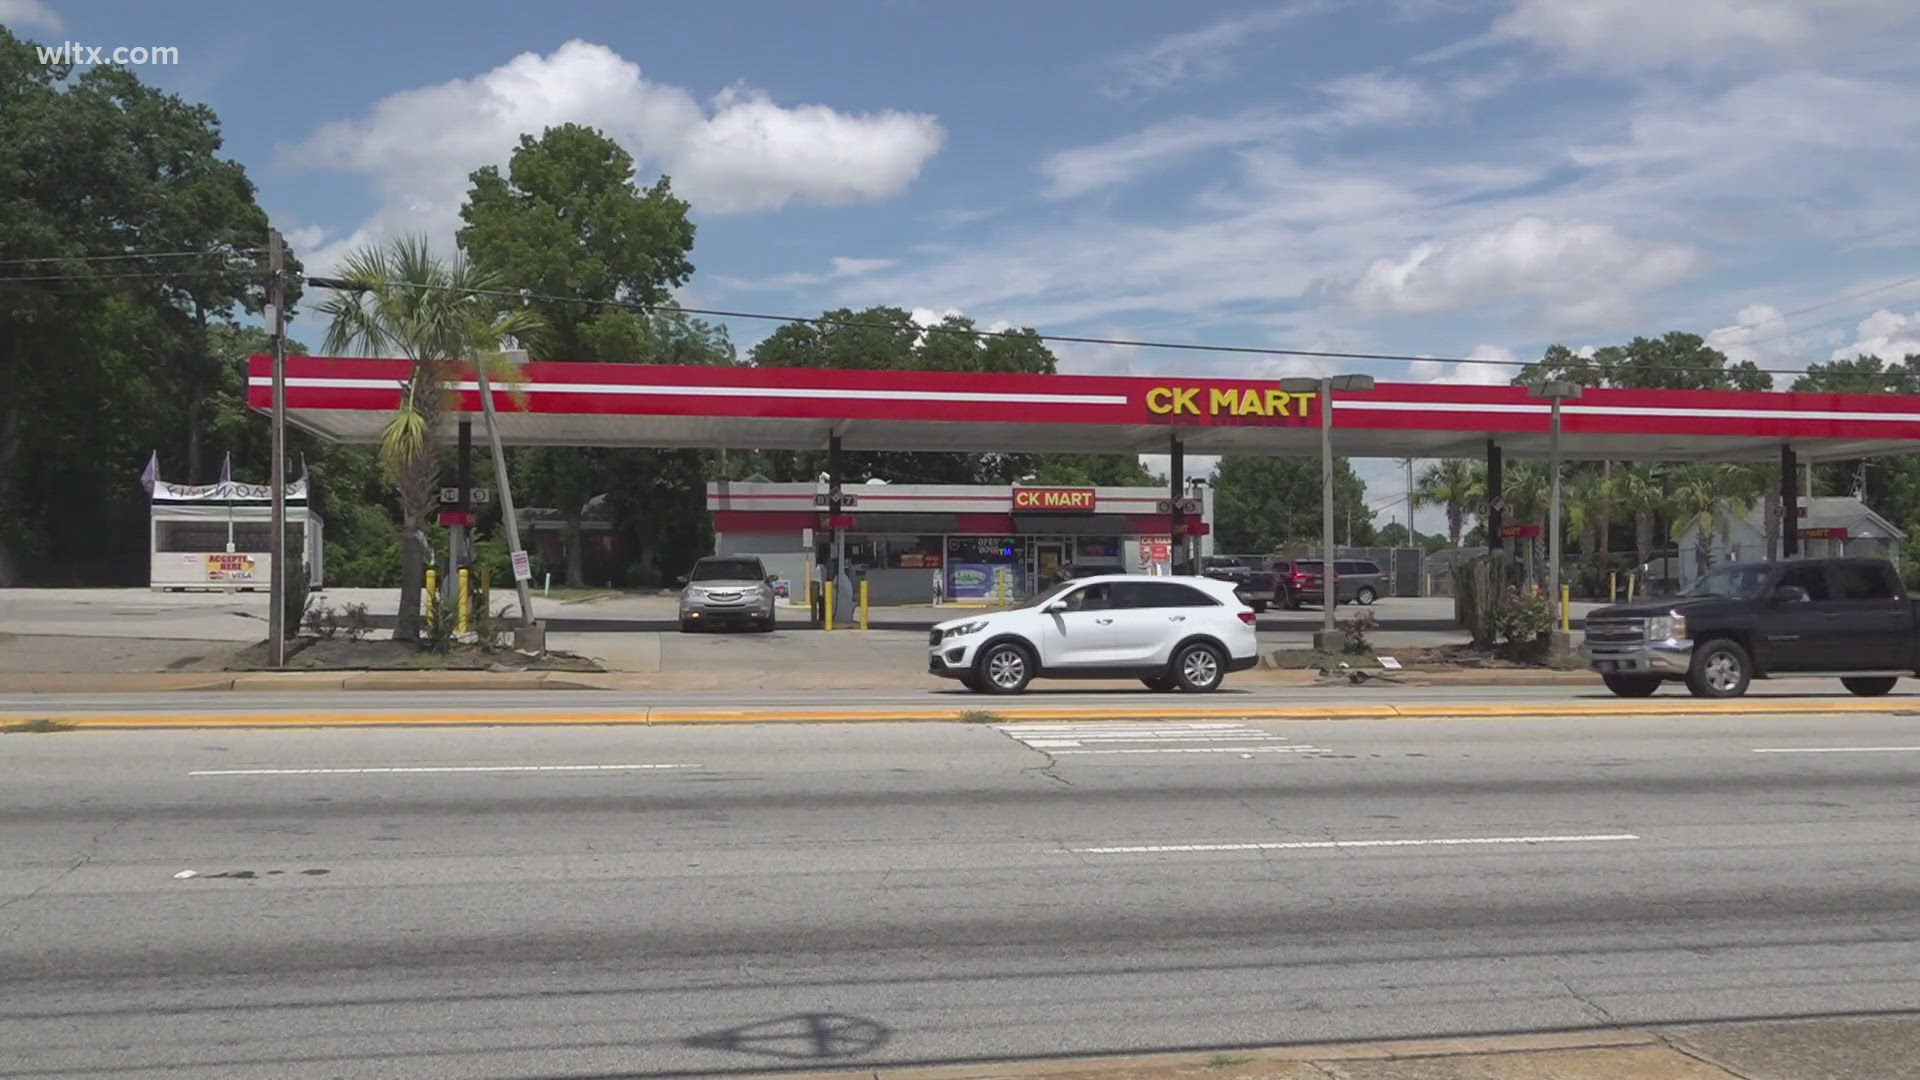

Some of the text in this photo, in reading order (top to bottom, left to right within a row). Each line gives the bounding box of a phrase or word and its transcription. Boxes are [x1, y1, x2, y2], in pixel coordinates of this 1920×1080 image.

[1146, 387, 1316, 417] CK MART
[166, 482, 298, 498] FIREWORS
[1015, 492, 1093, 507] CK MART
